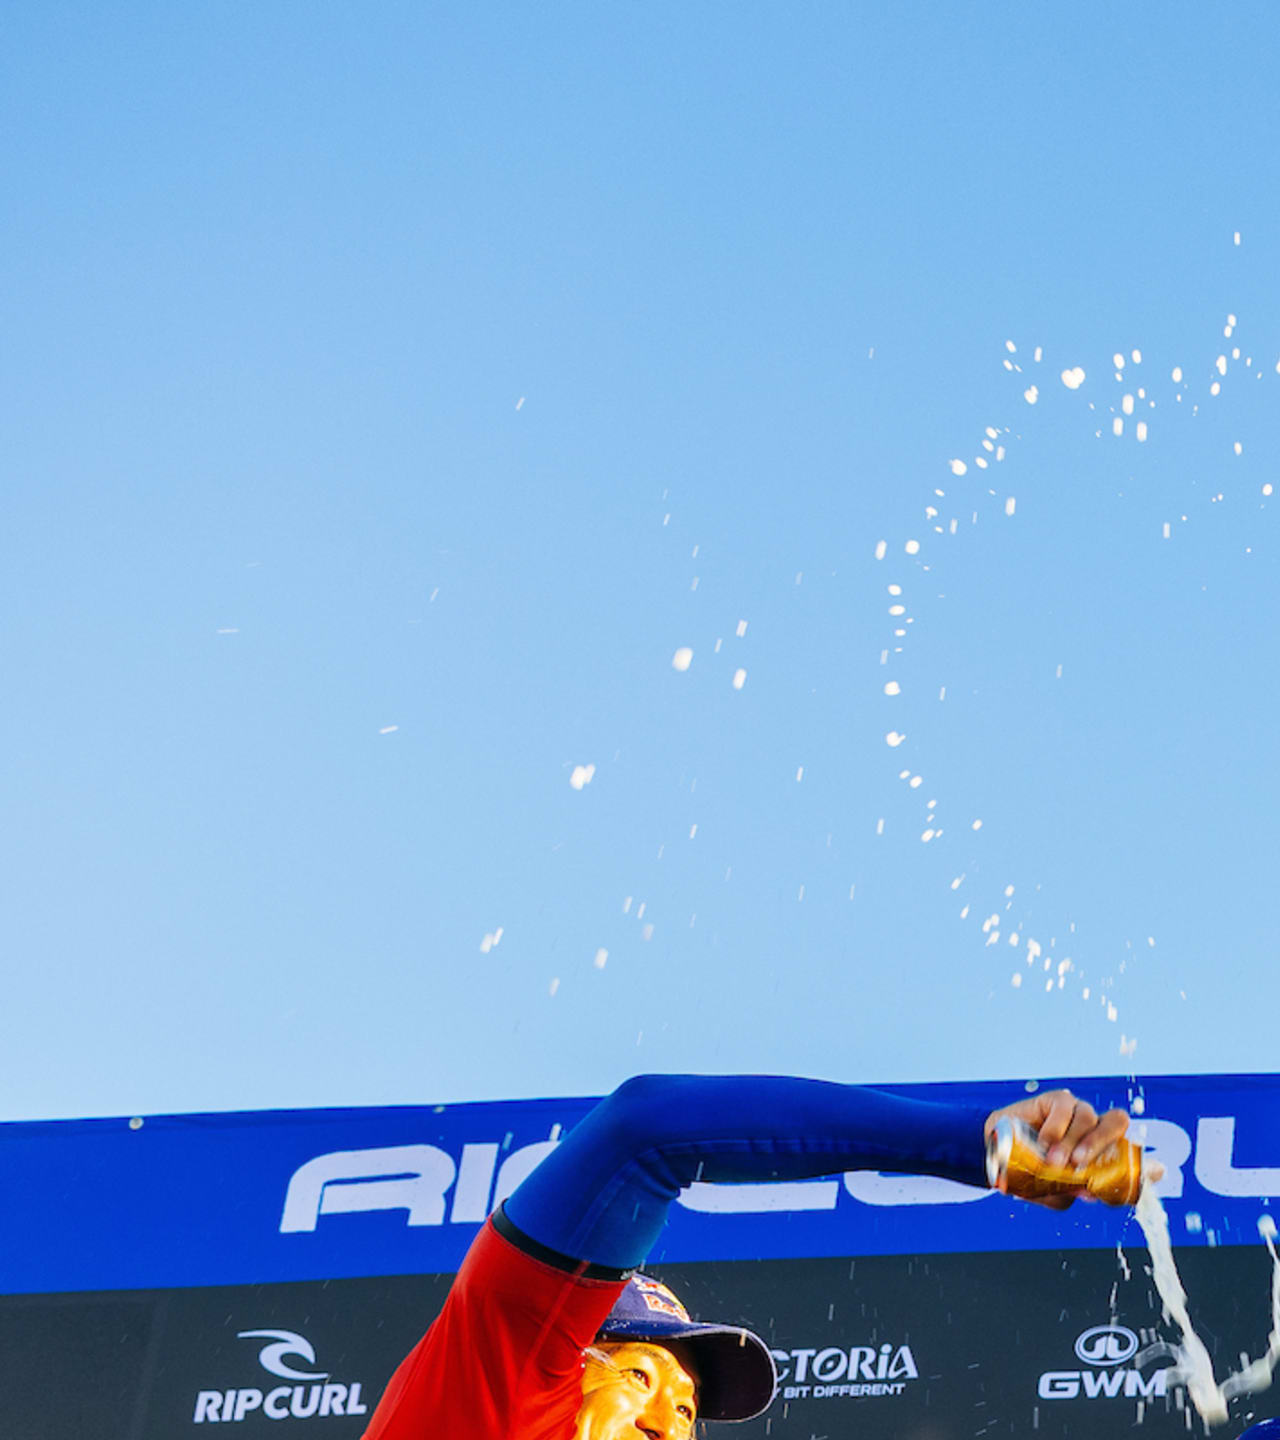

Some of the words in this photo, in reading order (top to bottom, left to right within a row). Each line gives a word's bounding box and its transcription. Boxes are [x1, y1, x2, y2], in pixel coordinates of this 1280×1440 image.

[194, 1387, 262, 1424] RIP
[262, 1382, 367, 1419] CURL
[784, 1385, 810, 1398] BIT
[813, 1382, 906, 1398] DIFFERENT
